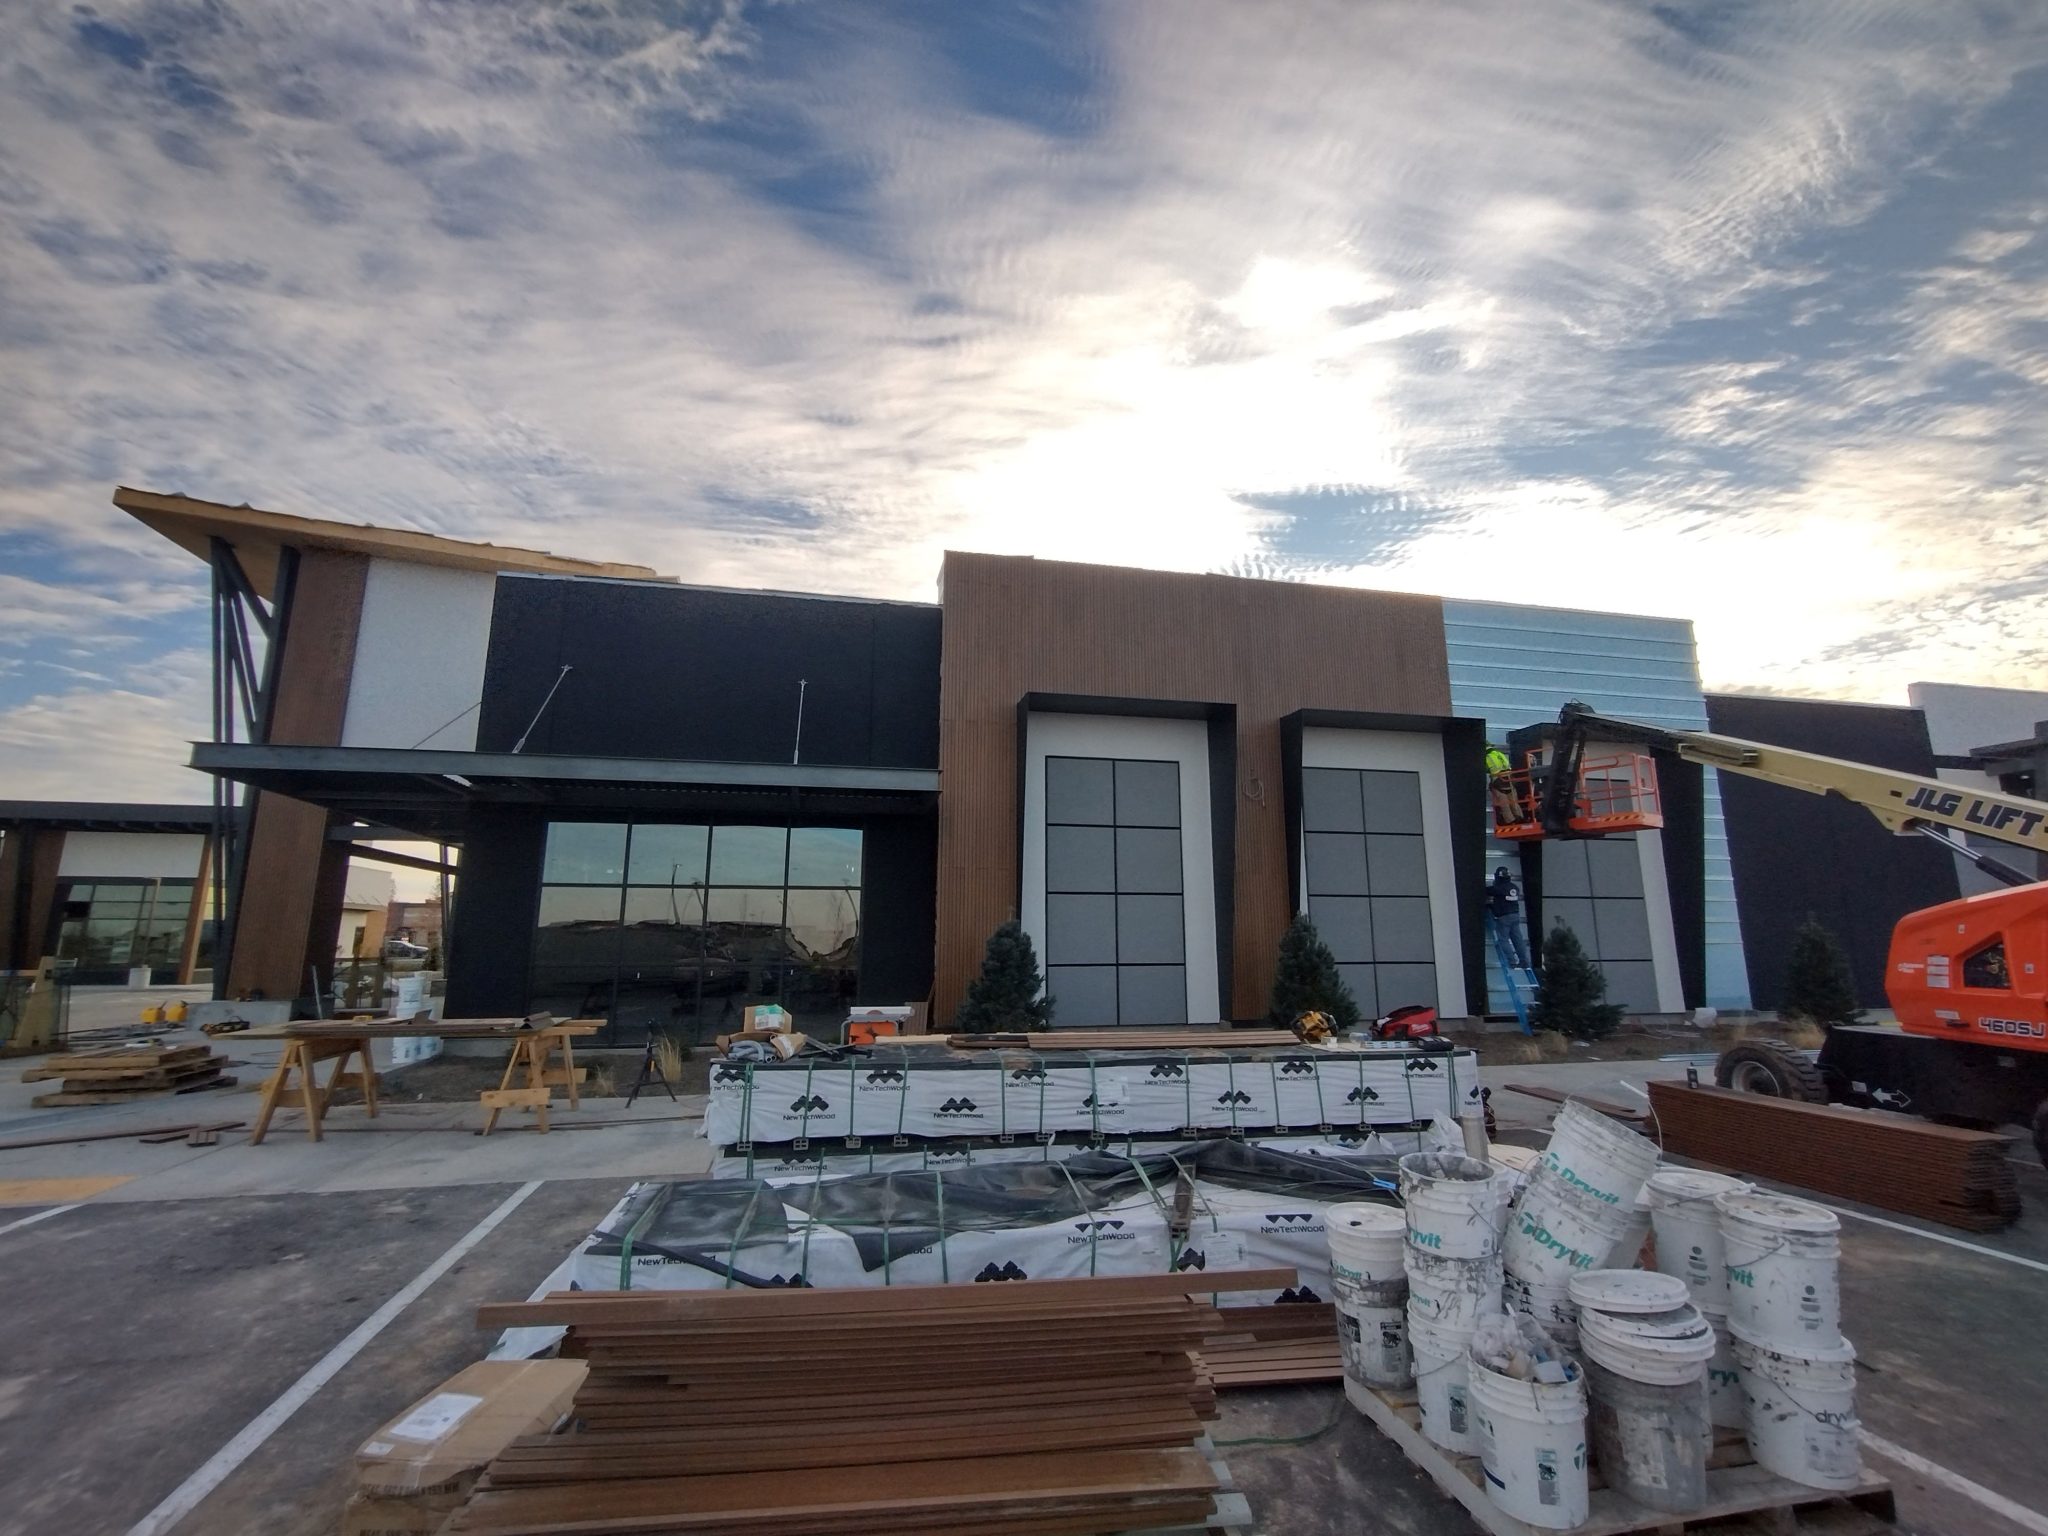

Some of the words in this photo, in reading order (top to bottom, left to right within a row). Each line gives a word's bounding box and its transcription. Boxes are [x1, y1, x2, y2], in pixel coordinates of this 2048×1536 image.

[1905, 787, 1963, 817] JLG
[1964, 800, 2045, 837] LIFT
[1979, 1018, 2045, 1038] 460SJ
[1067, 1231, 1136, 1245] NewTchWood
[1260, 1225, 1326, 1238] NewTechWood
